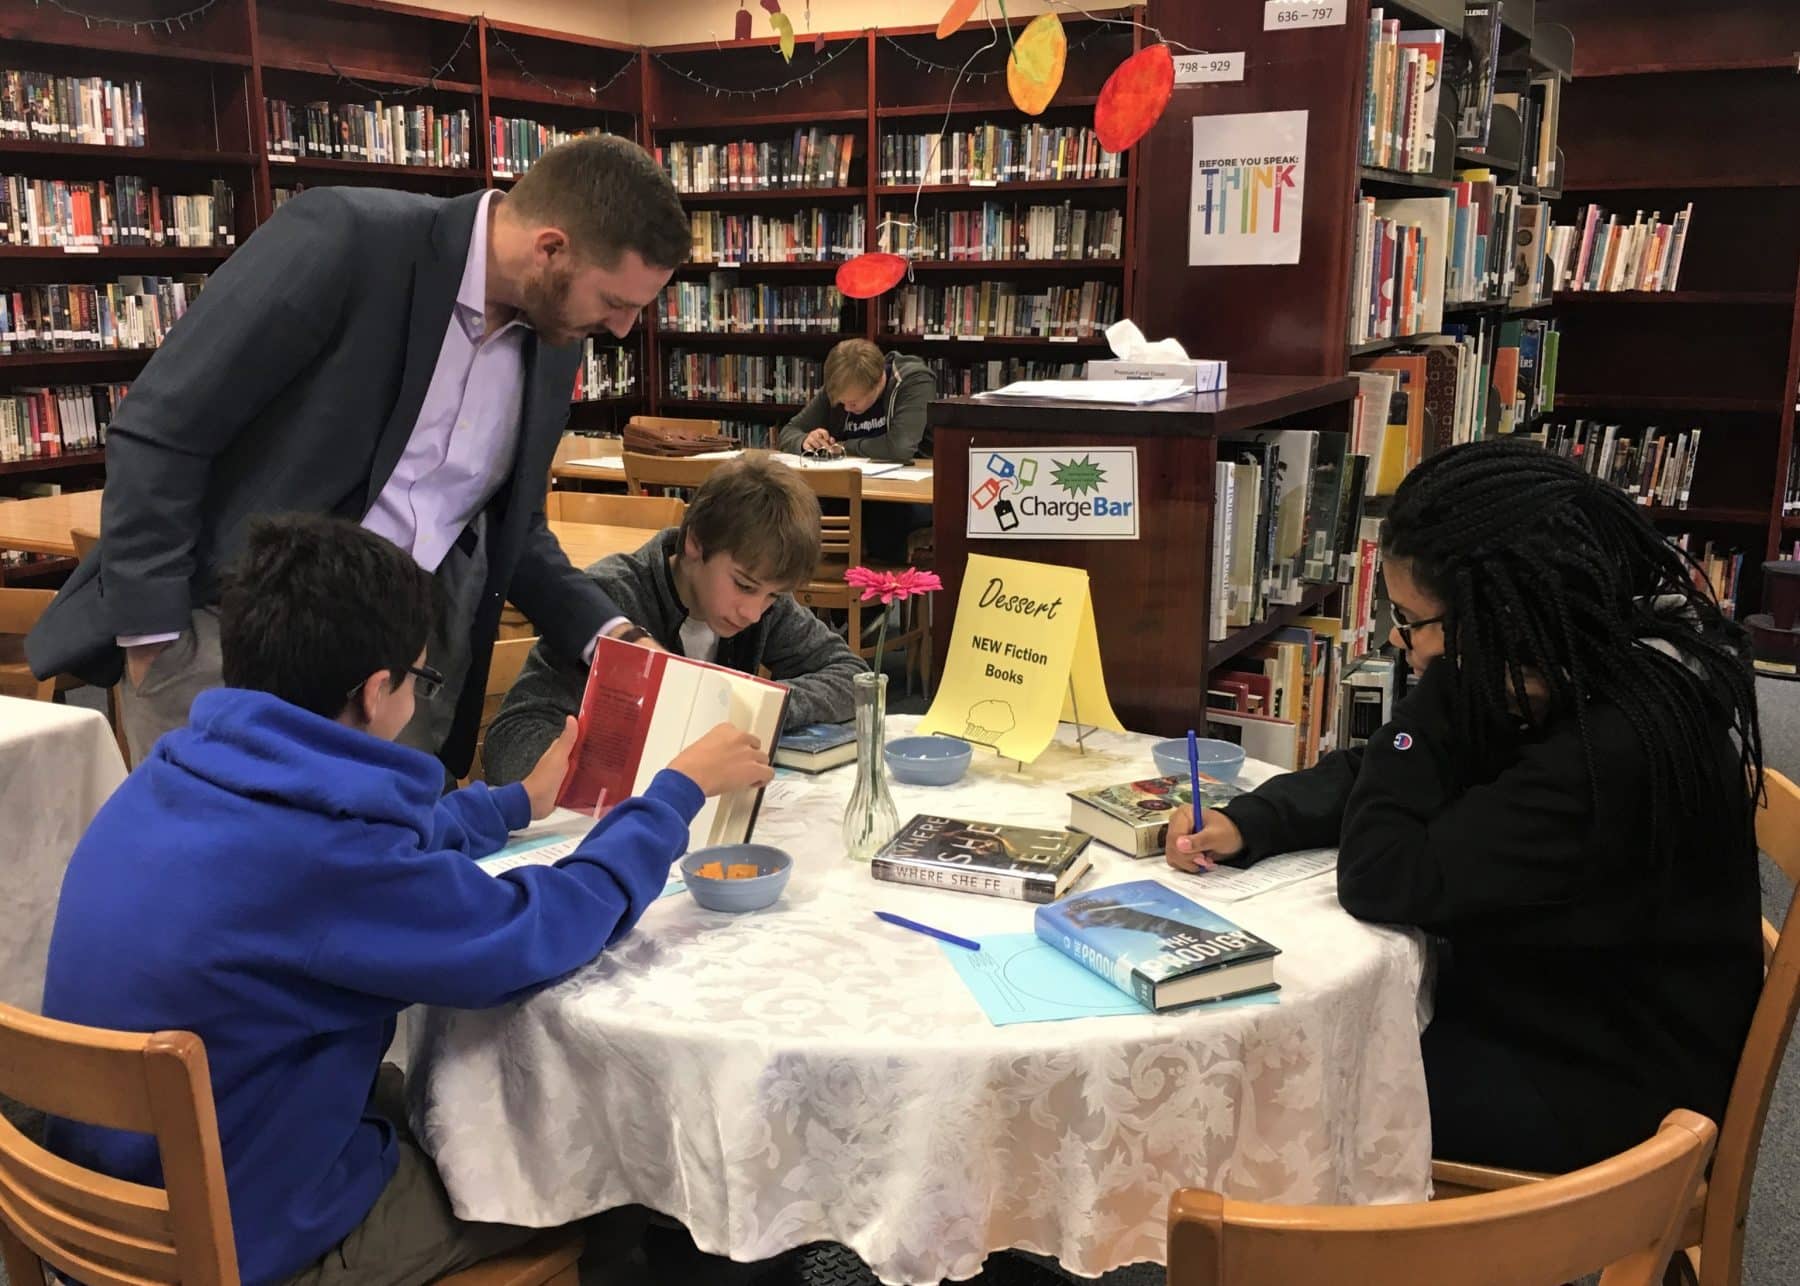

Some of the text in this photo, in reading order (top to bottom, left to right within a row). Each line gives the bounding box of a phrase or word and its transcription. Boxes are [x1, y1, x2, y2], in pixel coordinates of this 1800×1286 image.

[1278, 10, 1298, 23] 636
[1312, 7, 1333, 20] 797
[1178, 62, 1198, 73] 798
[1210, 60, 1231, 72] 929
[1199, 156, 1299, 168] BEFORE YOU SPEAK:
[1201, 165, 1297, 235] THINK
[1020, 496, 1133, 521] ChargeBar
[978, 578, 1063, 620] Dessert
[972, 635, 1048, 665] NEW Fiction
[985, 664, 1024, 685] Books
[893, 816, 951, 861] WHERE
[938, 824, 1002, 866] SHE
[895, 866, 1001, 892] WHERE SHE FE
[1139, 930, 1258, 976] PRODIGY
[1160, 932, 1199, 952] THE
[1082, 945, 1119, 978] PRODI
